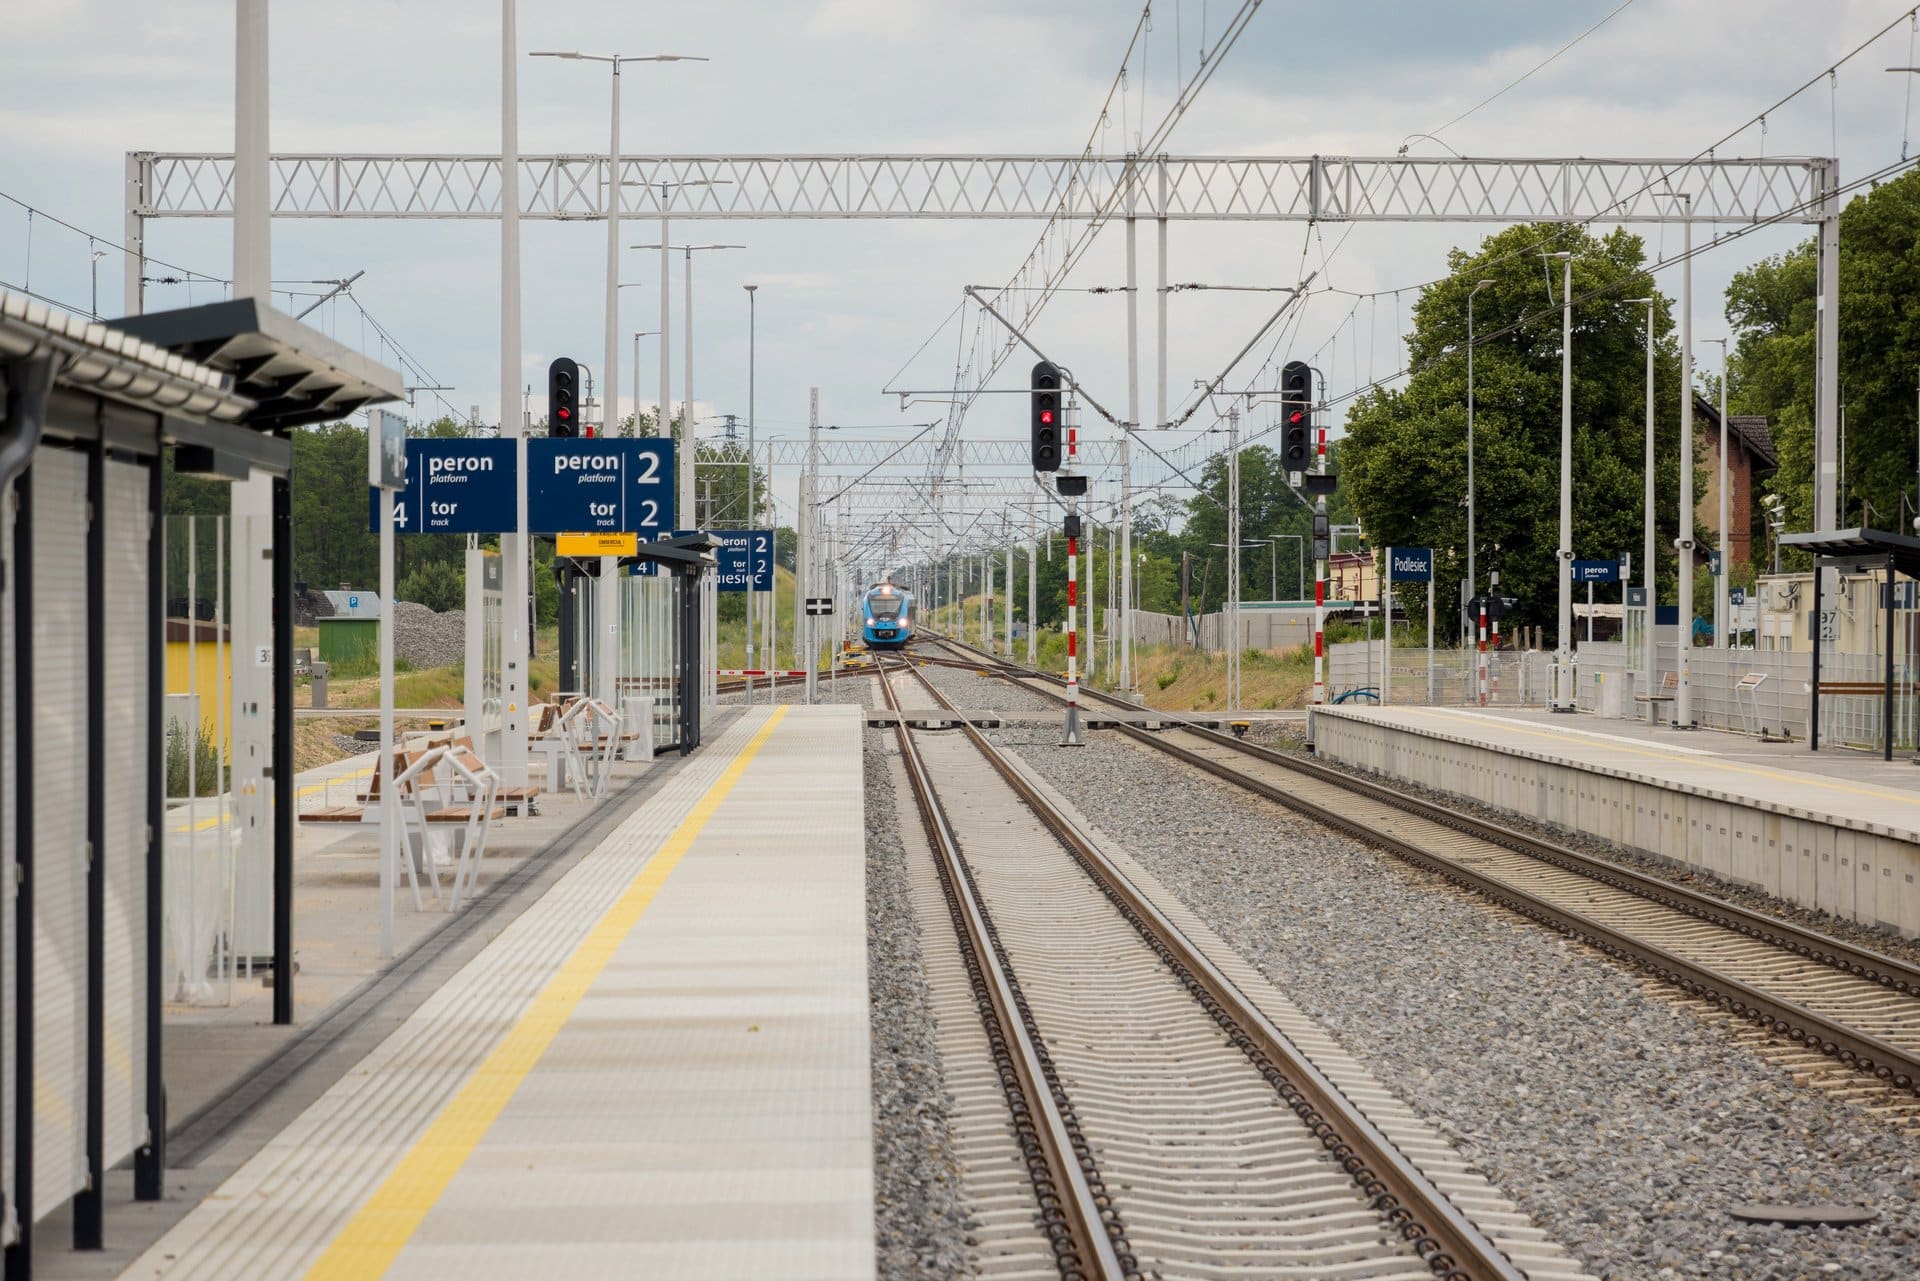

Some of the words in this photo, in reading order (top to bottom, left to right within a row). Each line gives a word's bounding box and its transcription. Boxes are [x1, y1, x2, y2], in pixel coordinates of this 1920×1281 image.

[429, 456, 493, 476] peron
[554, 455, 618, 475] peron
[637, 451, 660, 484] 2
[430, 473, 468, 485] platform
[577, 473, 616, 485] platform
[392, 502, 408, 528] 4
[430, 501, 458, 515] tor
[589, 502, 616, 516] tor
[640, 500, 659, 527] 2
[430, 518, 449, 526] track
[596, 518, 615, 526] track
[723, 538, 747, 546] eron
[755, 536, 767, 552] 2
[637, 562, 648, 574] 4
[733, 560, 746, 568] tor
[756, 559, 767, 573] 2
[1394, 556, 1428, 572] Podlesiec
[1584, 566, 1609, 576] peron
